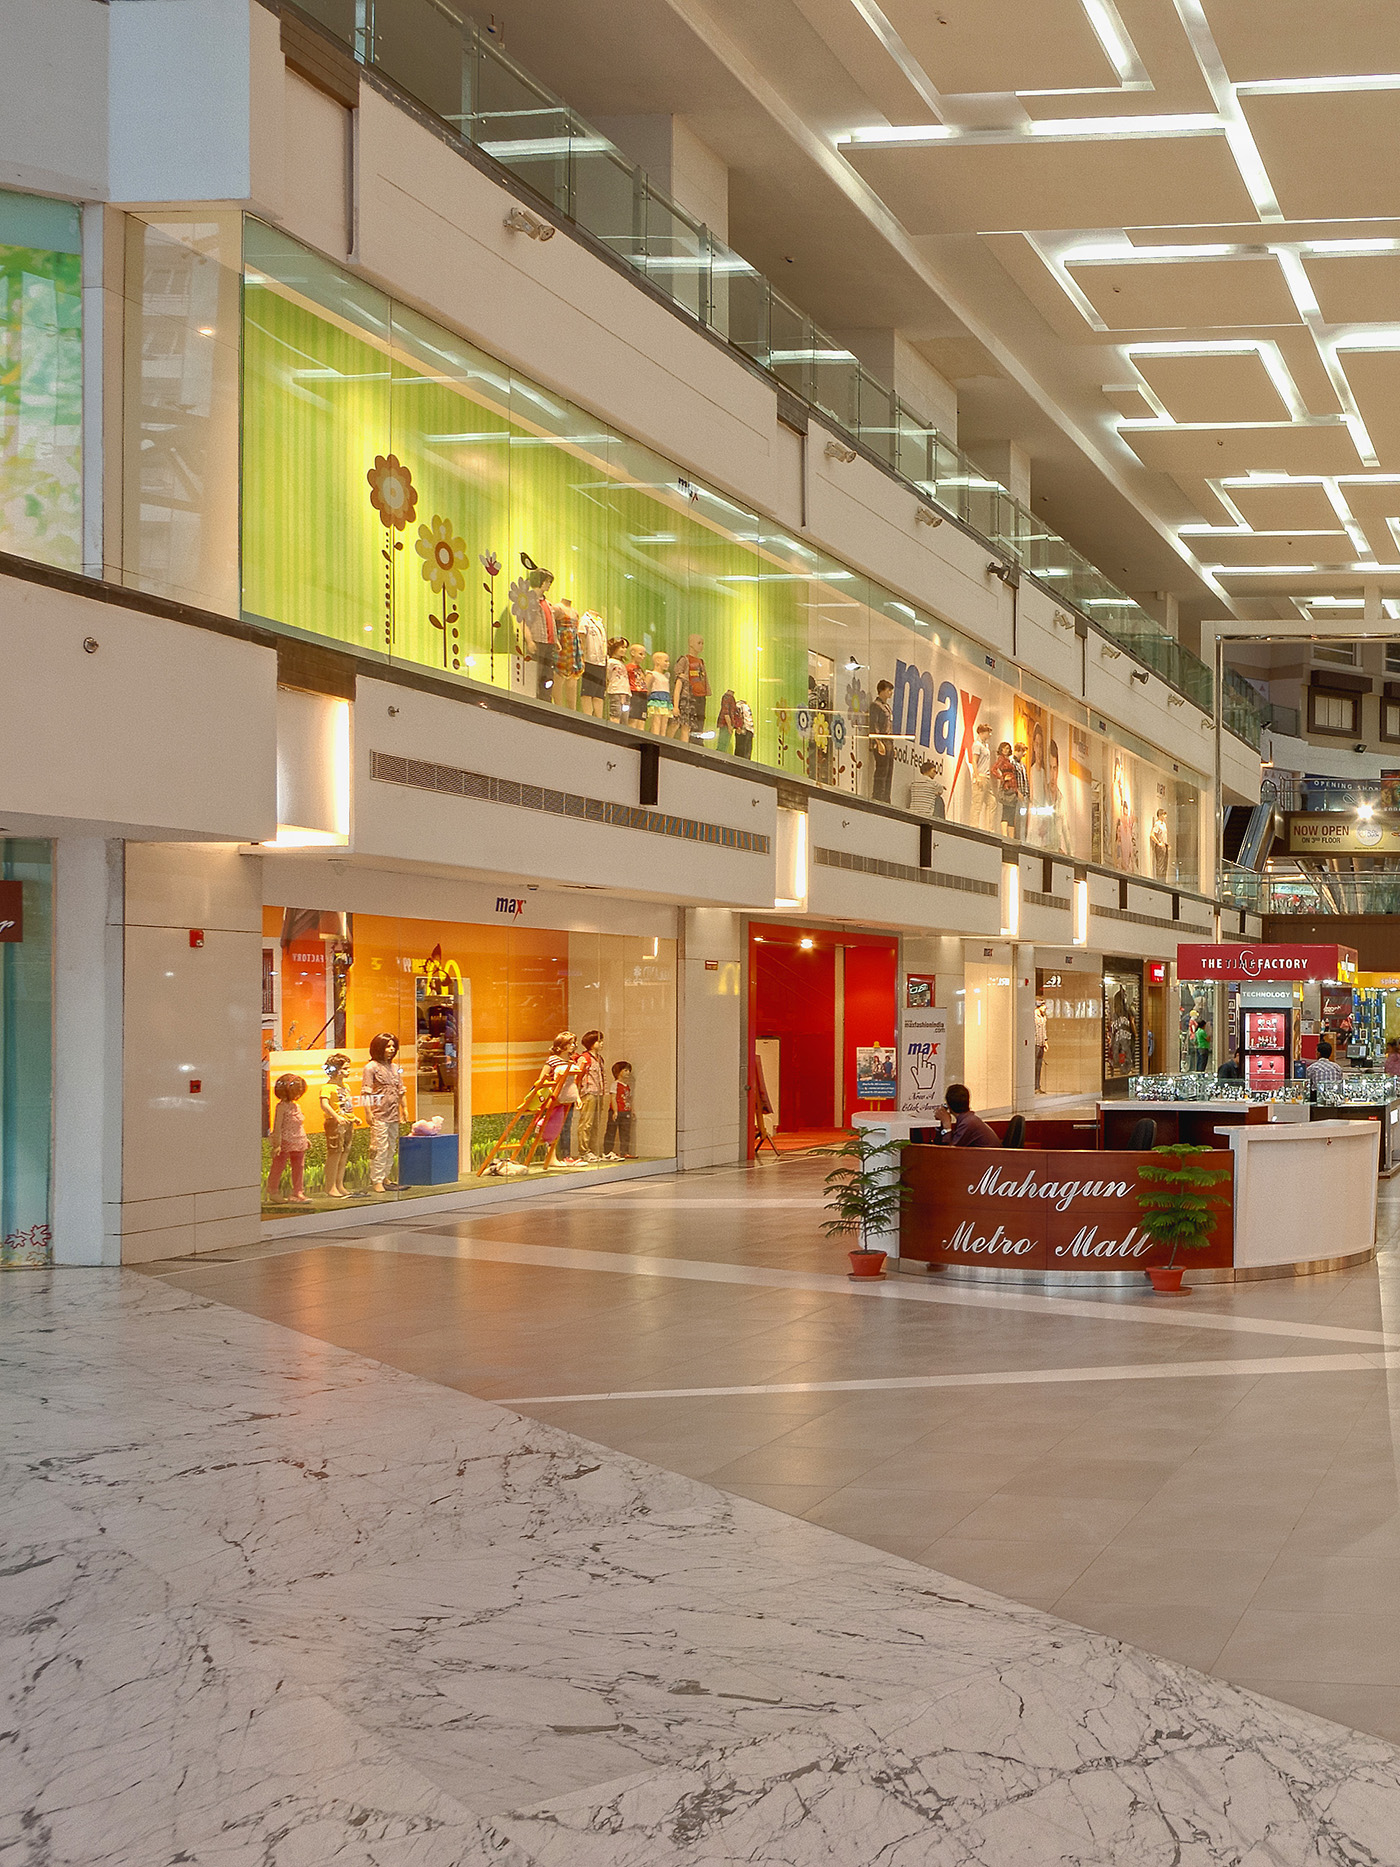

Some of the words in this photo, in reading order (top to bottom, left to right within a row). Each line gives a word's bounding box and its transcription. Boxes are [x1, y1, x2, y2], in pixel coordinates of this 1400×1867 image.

[893, 659, 982, 811] max
[1294, 825, 1319, 836] NOW
[1321, 825, 1349, 836] OPEN
[495, 897, 527, 923] max
[1201, 958, 1223, 969] THE
[1257, 958, 1308, 969] FACTORY
[1381, 977, 1400, 985] spice
[907, 1043, 940, 1061] max
[967, 1165, 1136, 1212] Mahagun
[941, 1220, 1039, 1255] Metro
[1054, 1225, 1154, 1258] Mall
